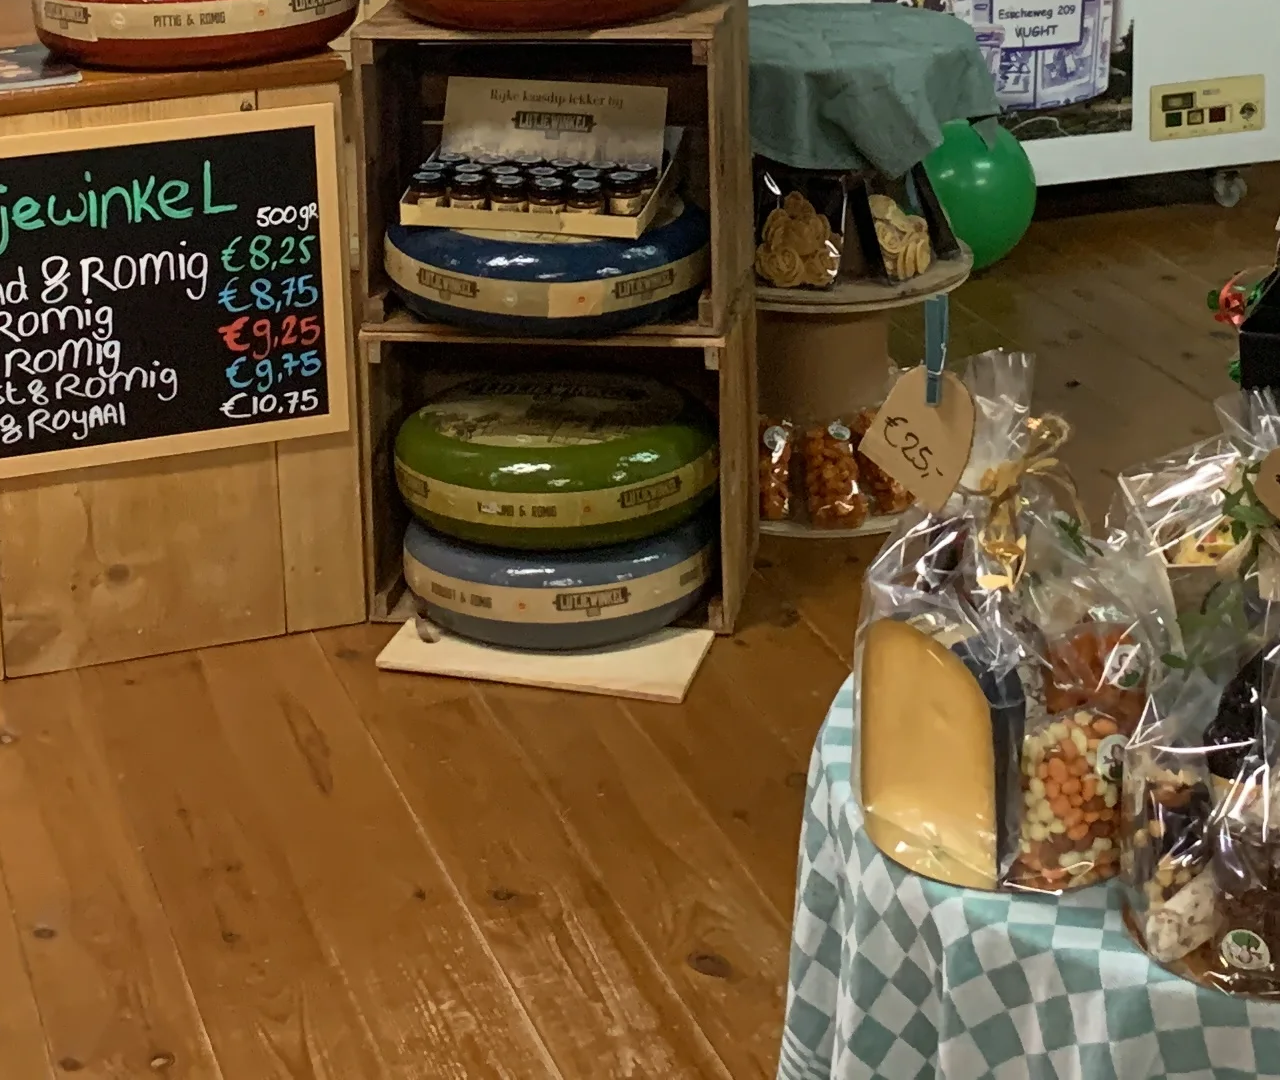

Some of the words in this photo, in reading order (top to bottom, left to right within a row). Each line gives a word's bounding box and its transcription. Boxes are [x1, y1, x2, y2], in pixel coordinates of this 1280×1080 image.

[153, 15, 183, 28] PITTIG
[186, 14, 196, 26] &
[200, 12, 226, 25] ROMIG
[1057, 4, 1076, 16] 209
[1015, 24, 1058, 38] VUGHT
[40, 255, 71, 304] &
[220, 234, 317, 273] €8,25
[217, 273, 319, 313] €8,75
[217, 315, 321, 360] €9,25
[27, 378, 50, 406] &
[225, 349, 323, 393] €9,75
